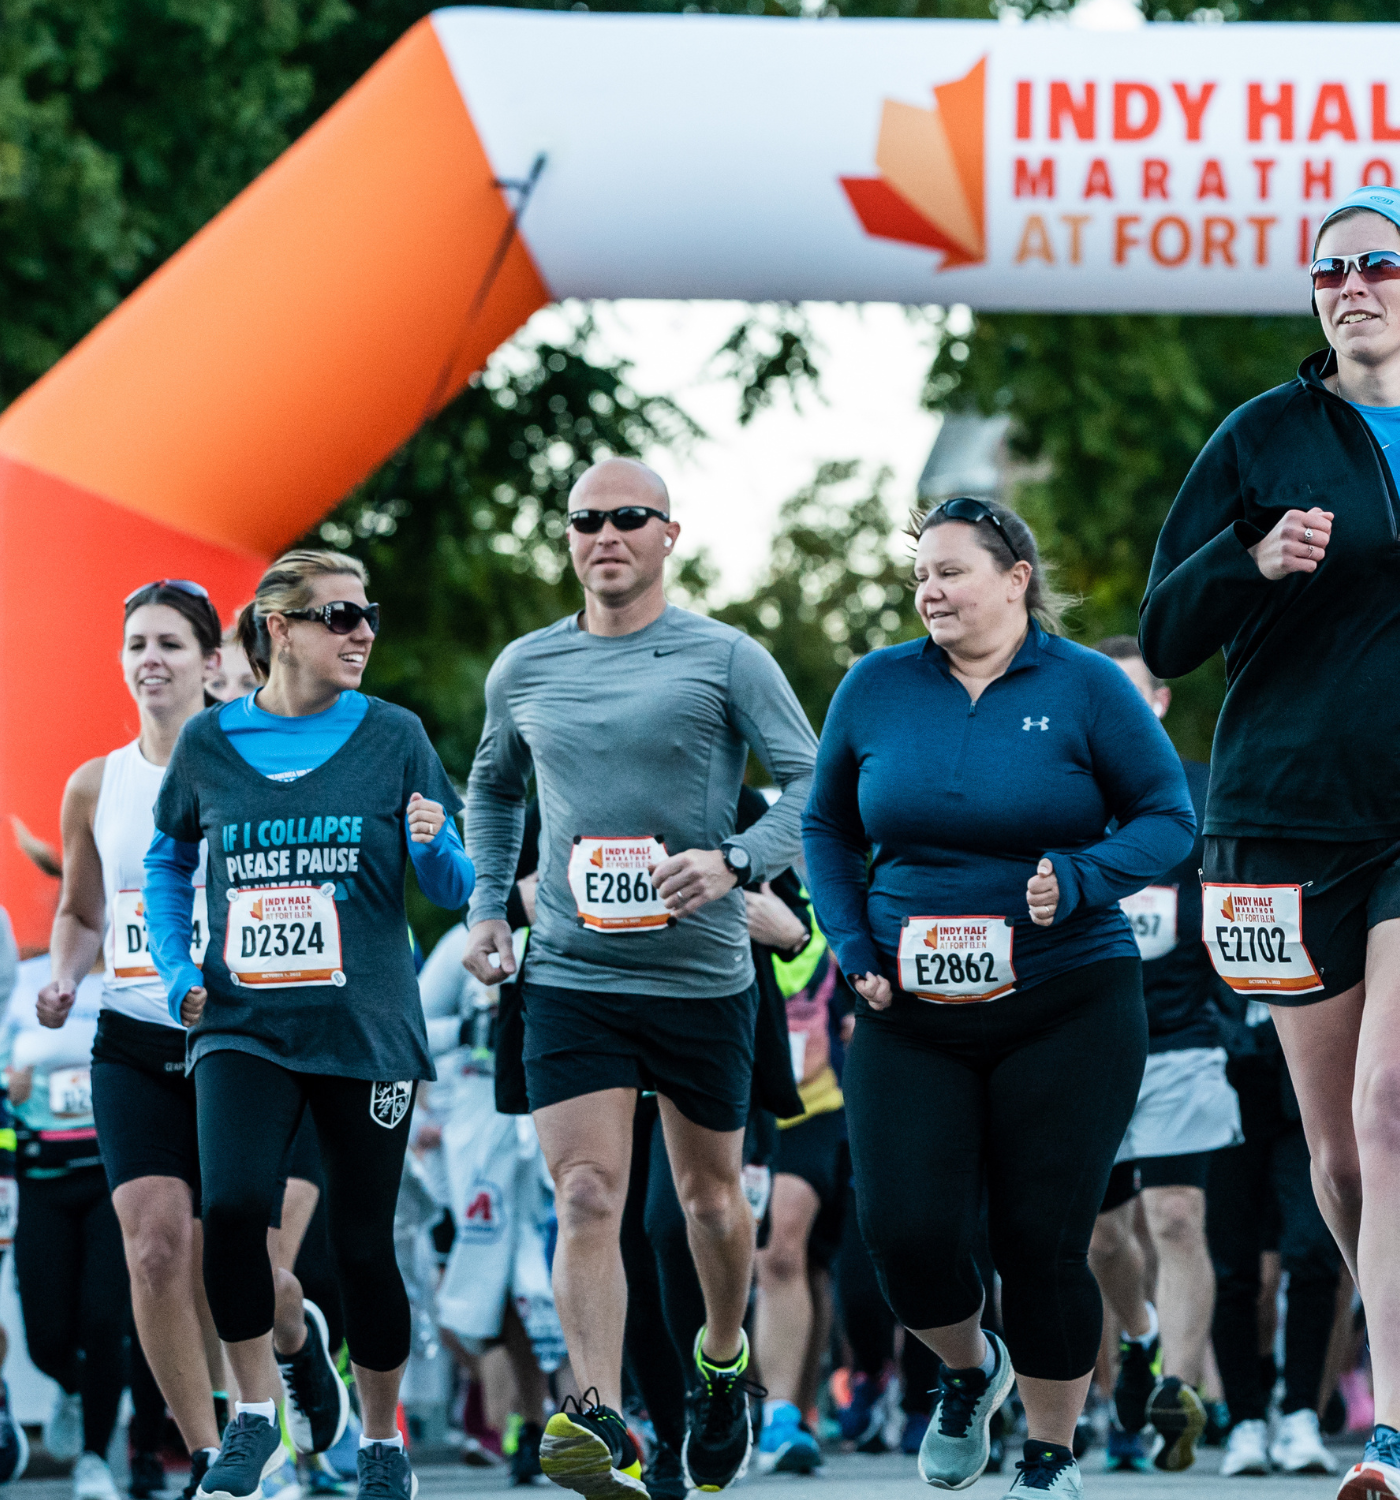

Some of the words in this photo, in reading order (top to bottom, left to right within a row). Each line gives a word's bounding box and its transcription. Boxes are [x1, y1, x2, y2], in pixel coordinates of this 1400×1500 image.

[1014, 80, 1217, 142] INDY
[1013, 215, 1091, 267] AT
[1113, 214, 1280, 268] FORT
[223, 823, 238, 852] IF
[243, 821, 251, 849] I
[258, 815, 363, 848] COLLAPSE
[605, 847, 626, 855] INDY
[629, 846, 651, 855] HALF
[226, 849, 290, 883] PLEASE
[296, 847, 360, 875] PAUSE
[265, 897, 286, 907] INDY
[288, 895, 311, 905] HALF
[1233, 896, 1252, 907] INDY
[1253, 896, 1273, 908] HALF
[275, 911, 293, 920] FORT
[1235, 906, 1274, 914] MARATHON
[1236, 914, 1245, 922] AT
[1245, 914, 1260, 923] FORT
[940, 926, 962, 935] INDY
[963, 926, 987, 935] HALF
[241, 921, 325, 958] D2324
[1215, 926, 1292, 963] E2702
[940, 942, 948, 950] AT
[915, 952, 999, 986] E2862
